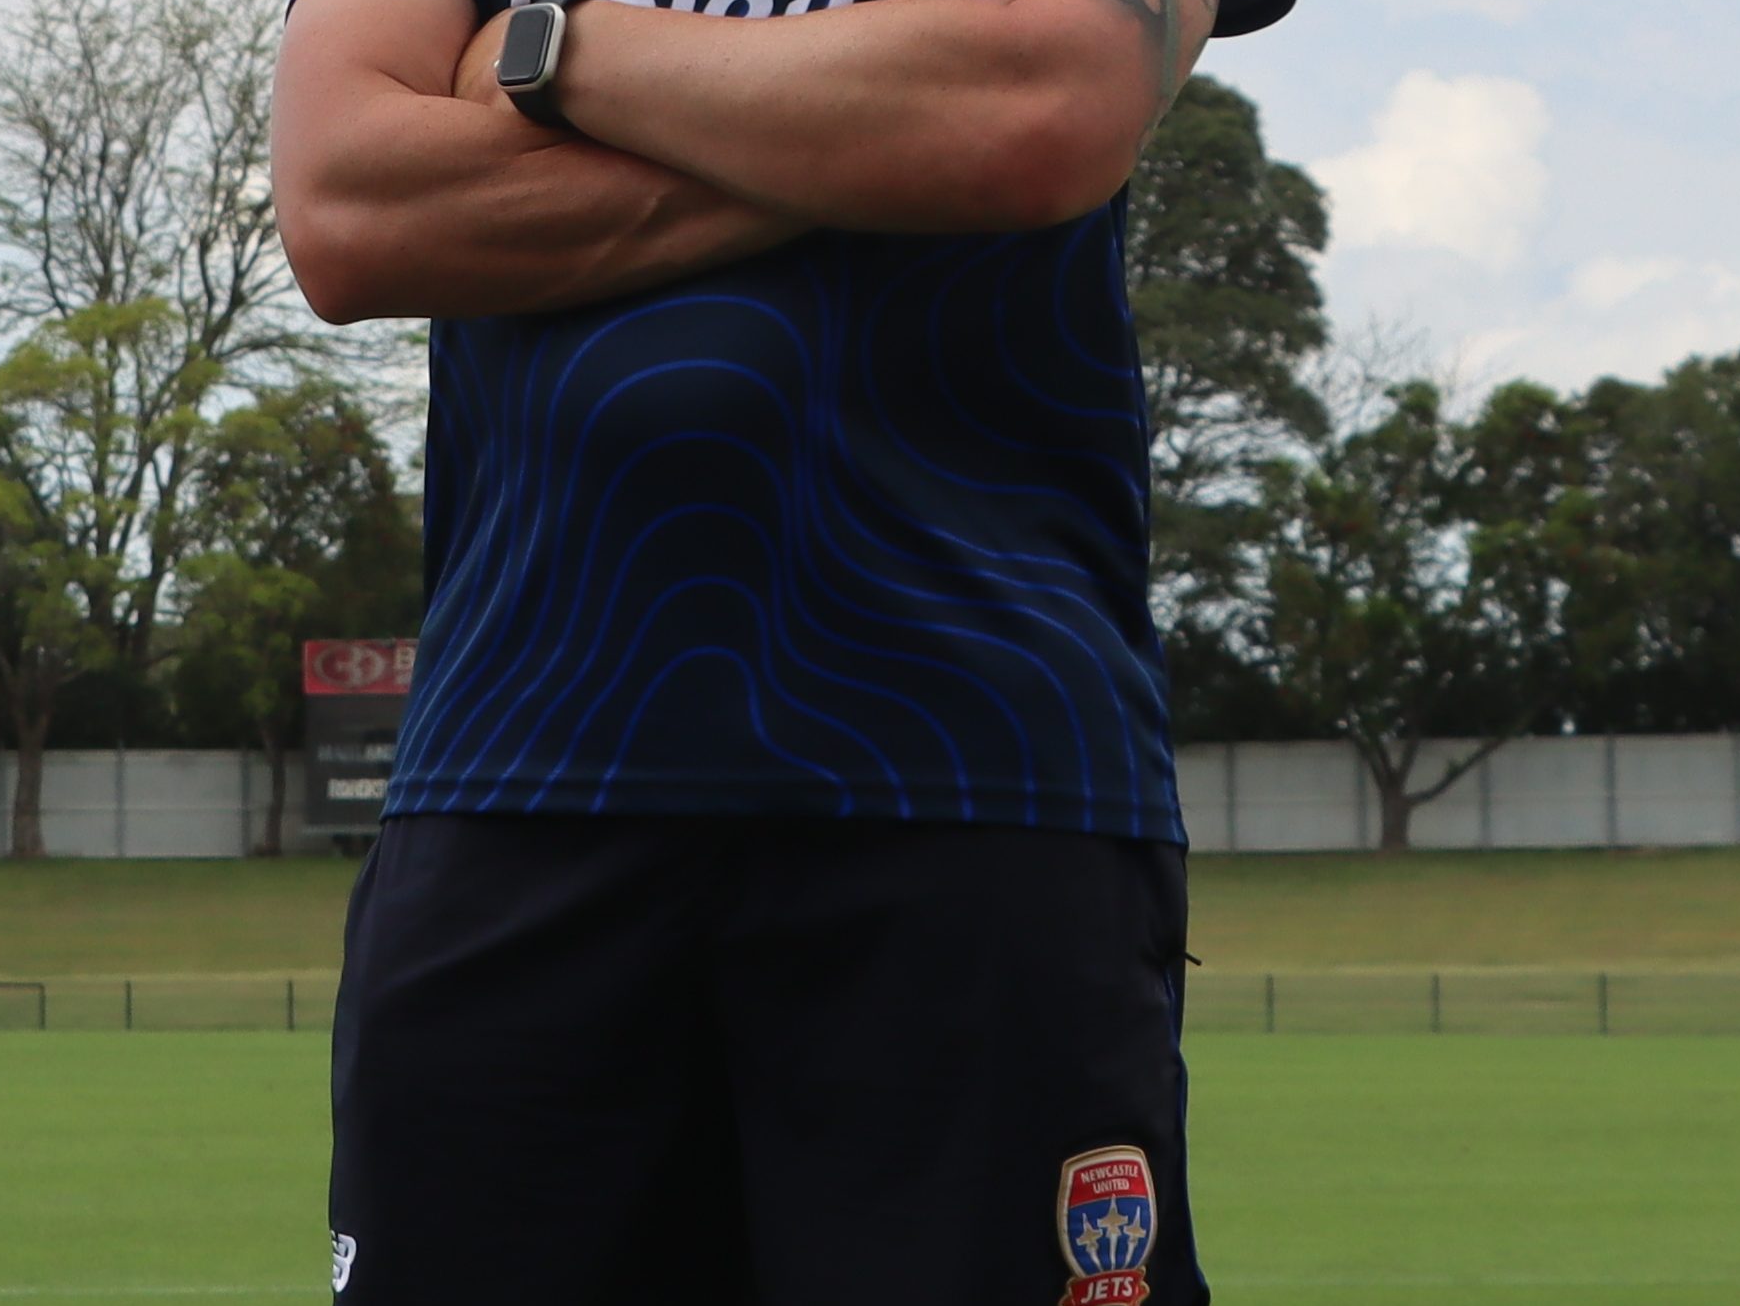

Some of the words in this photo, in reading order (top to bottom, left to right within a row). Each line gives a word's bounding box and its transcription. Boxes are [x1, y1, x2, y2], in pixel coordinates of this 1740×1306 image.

[1080, 1164, 1139, 1184] NEWCASTLE
[1092, 1177, 1130, 1194] UNITED
[1080, 1276, 1134, 1305] JETS
